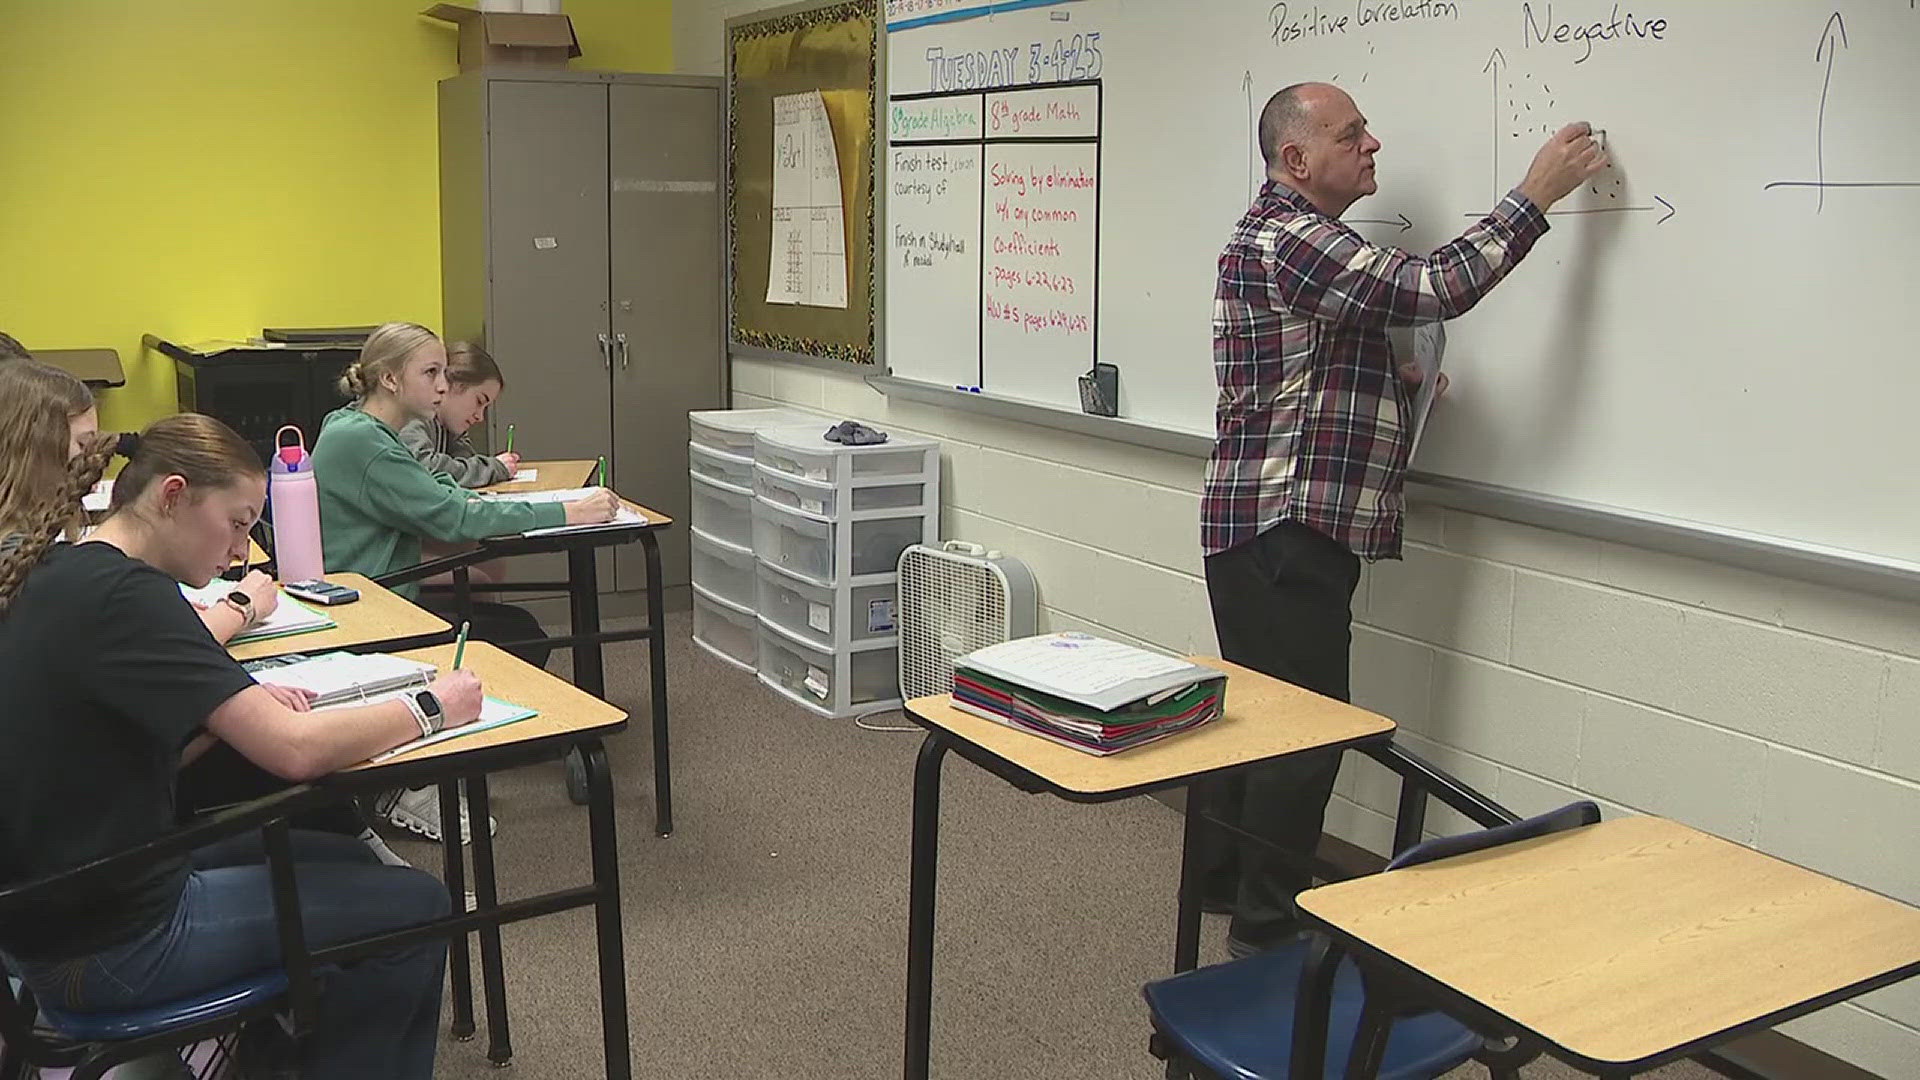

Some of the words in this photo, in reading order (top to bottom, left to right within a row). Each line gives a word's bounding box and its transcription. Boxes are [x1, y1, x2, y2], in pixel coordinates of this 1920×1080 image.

[1269, 2, 1348, 46] Positive
[1523, 2, 1668, 64] Negative
[926, 47, 1019, 92] TUESDAY
[930, 107, 977, 137] Algebra
[1012, 106, 1042, 132] grade
[1046, 102, 1080, 121] Math
[894, 152, 923, 172] Finish
[894, 179, 932, 204] courtesy
[936, 178, 948, 196] of
[991, 163, 1026, 196] Solving
[1030, 165, 1043, 194] by
[1031, 208, 1077, 222] common
[895, 224, 918, 249] Finish
[1024, 312, 1047, 333] pages
